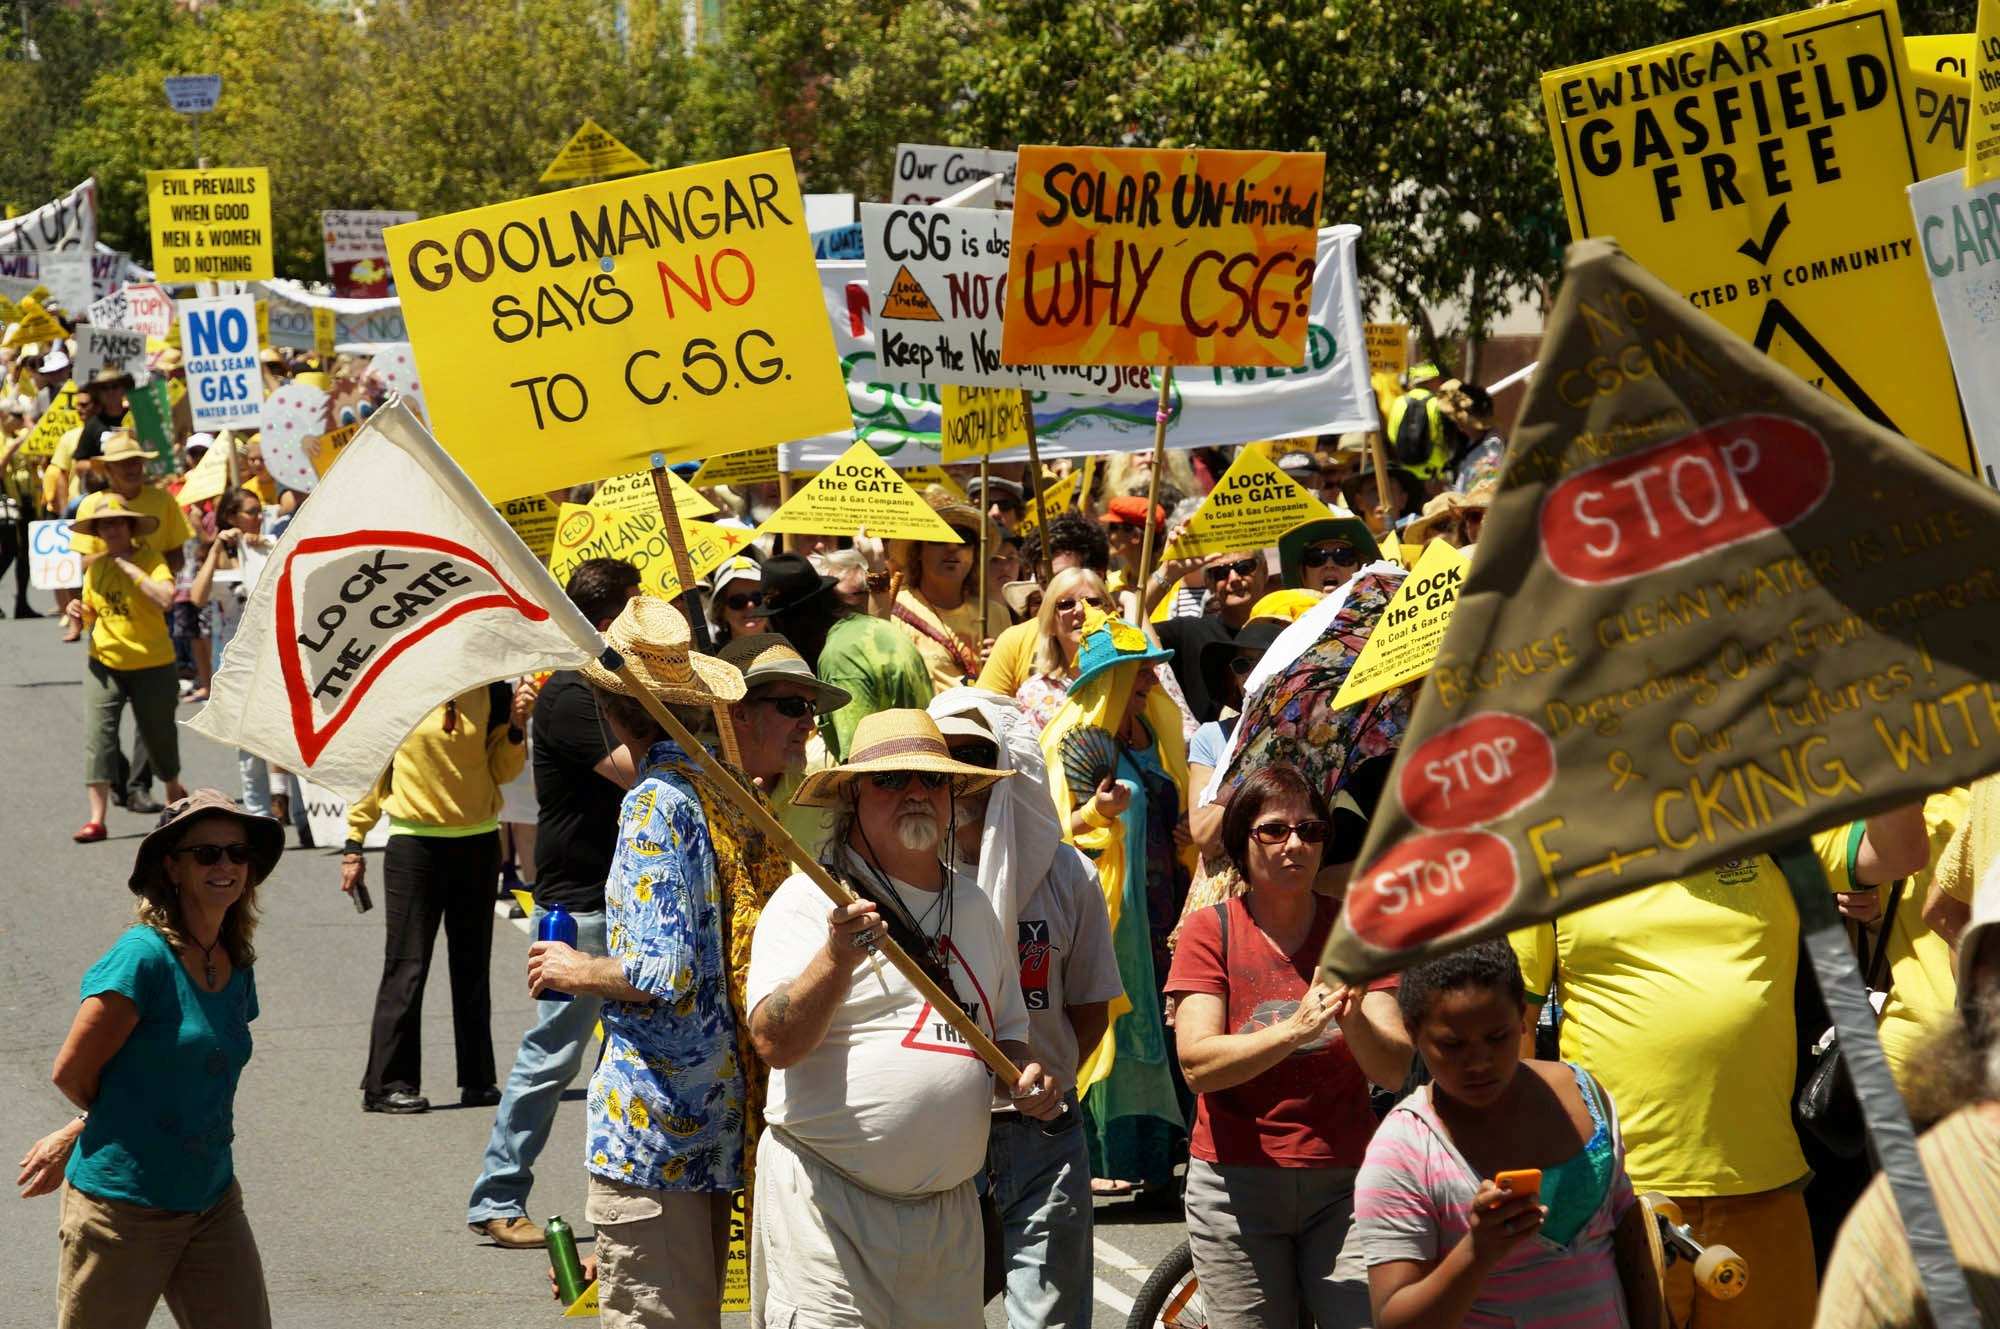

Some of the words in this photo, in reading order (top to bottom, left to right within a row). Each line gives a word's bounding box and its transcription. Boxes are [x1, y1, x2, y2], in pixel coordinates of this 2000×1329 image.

[1561, 30, 1772, 118] EWINGAR
[1793, 38, 1817, 65] IS
[1579, 53, 1888, 177] GASFIELD
[901, 151, 938, 180] Our
[1652, 125, 1842, 223] FREE
[162, 179, 189, 195] EVIL
[193, 177, 256, 195] PREVAILS
[1037, 162, 1161, 228] SOLAR
[171, 204, 210, 221] WHEN
[215, 203, 249, 220] GOOD
[408, 173, 793, 291] GOOLMANGAR
[162, 231, 191, 247] MEN
[195, 231, 204, 247] &
[209, 229, 262, 247] WOMEN
[883, 209, 951, 262] CSG
[961, 228, 979, 257] is
[986, 226, 1010, 258] abs
[173, 257, 191, 273] DO
[194, 255, 252, 273] NOTHING
[1747, 274, 1772, 297] BY
[1783, 238, 1912, 287] COMMUNITY
[492, 274, 633, 343] SAYS
[657, 248, 756, 319] NO
[1024, 236, 1163, 328] WHY
[1180, 250, 1317, 339] CSG?
[90, 334, 140, 356] FARMS
[188, 307, 248, 356] NO
[187, 360, 218, 373] COAL
[222, 356, 256, 371] SEAM
[882, 329, 934, 378] Keep
[936, 335, 963, 371] the
[201, 374, 248, 403] GAS
[511, 373, 588, 429] TO
[625, 329, 792, 405] C.S.G.
[195, 406, 226, 418] WATER
[230, 404, 239, 416] IS
[241, 403, 260, 415] LIFE
[948, 410, 985, 446] NORTH
[603, 483, 625, 496] the
[631, 478, 651, 490] GA
[818, 478, 848, 490] the
[855, 480, 903, 493] GATE
[836, 465, 886, 479] LOCK
[1229, 472, 1278, 489] LOCK
[507, 499, 546, 515] GATE
[818, 494, 837, 502] Coal
[850, 495, 865, 504] Gas
[868, 496, 914, 507] Companies
[1205, 512, 1213, 520] To
[1216, 510, 1234, 519] Coal
[1238, 508, 1243, 516] &
[1246, 507, 1261, 515] Gas
[1264, 502, 1308, 513] Companies
[1213, 493, 1242, 506] the
[1249, 485, 1296, 502] GATE
[1573, 437, 1759, 559] STOP
[552, 512, 656, 590] FARMLAND
[298, 550, 408, 653] LOCK
[1405, 565, 1462, 602] LOCK
[1387, 605, 1419, 627] the
[1426, 584, 1462, 611] GA
[313, 637, 376, 700] THE
[370, 561, 472, 629] GATE
[1376, 638, 1385, 649] To
[1388, 627, 1408, 644] Coal
[1411, 624, 1418, 633] &
[1421, 616, 1438, 629] Gas
[1434, 630, 1577, 710] BECAUSE
[1596, 587, 1712, 650] CLEAN
[1425, 736, 1518, 809] STOP
[1374, 848, 1473, 915] STOP
